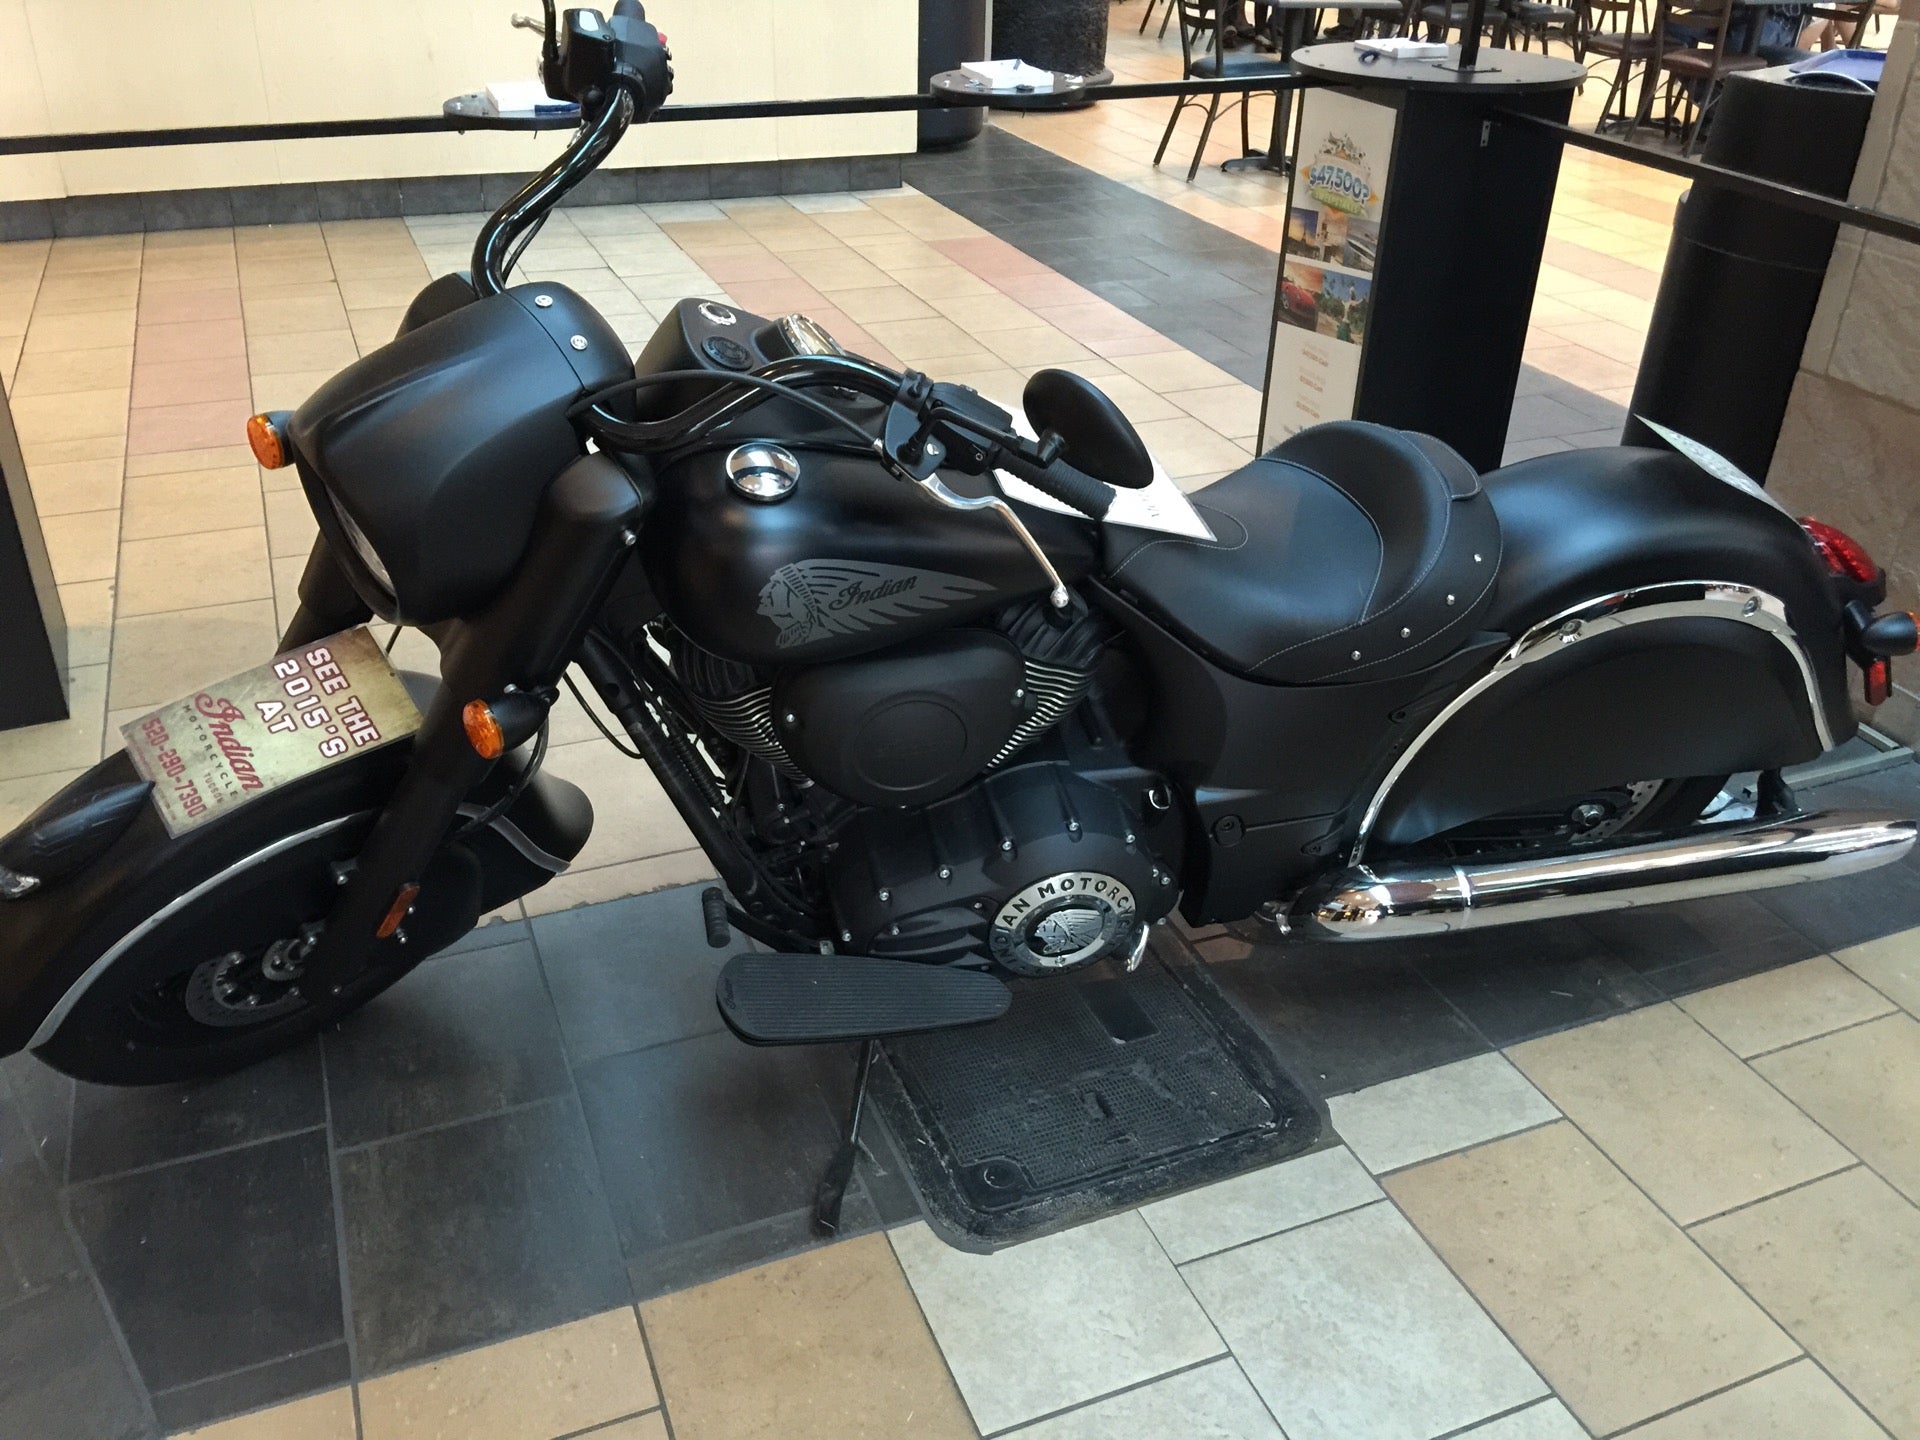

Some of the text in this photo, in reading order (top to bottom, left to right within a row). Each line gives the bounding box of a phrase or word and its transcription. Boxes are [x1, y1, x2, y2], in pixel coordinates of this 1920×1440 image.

[829, 575, 917, 610] Indian
[195, 693, 264, 791] Indian
[254, 700, 298, 734] AT
[273, 659, 349, 759] 2015'S
[305, 647, 382, 747] SEE THE
[142, 717, 208, 818] 520-290-7390
[182, 704, 239, 798] MOTORCYCLE
[203, 772, 225, 803] TUCSON
